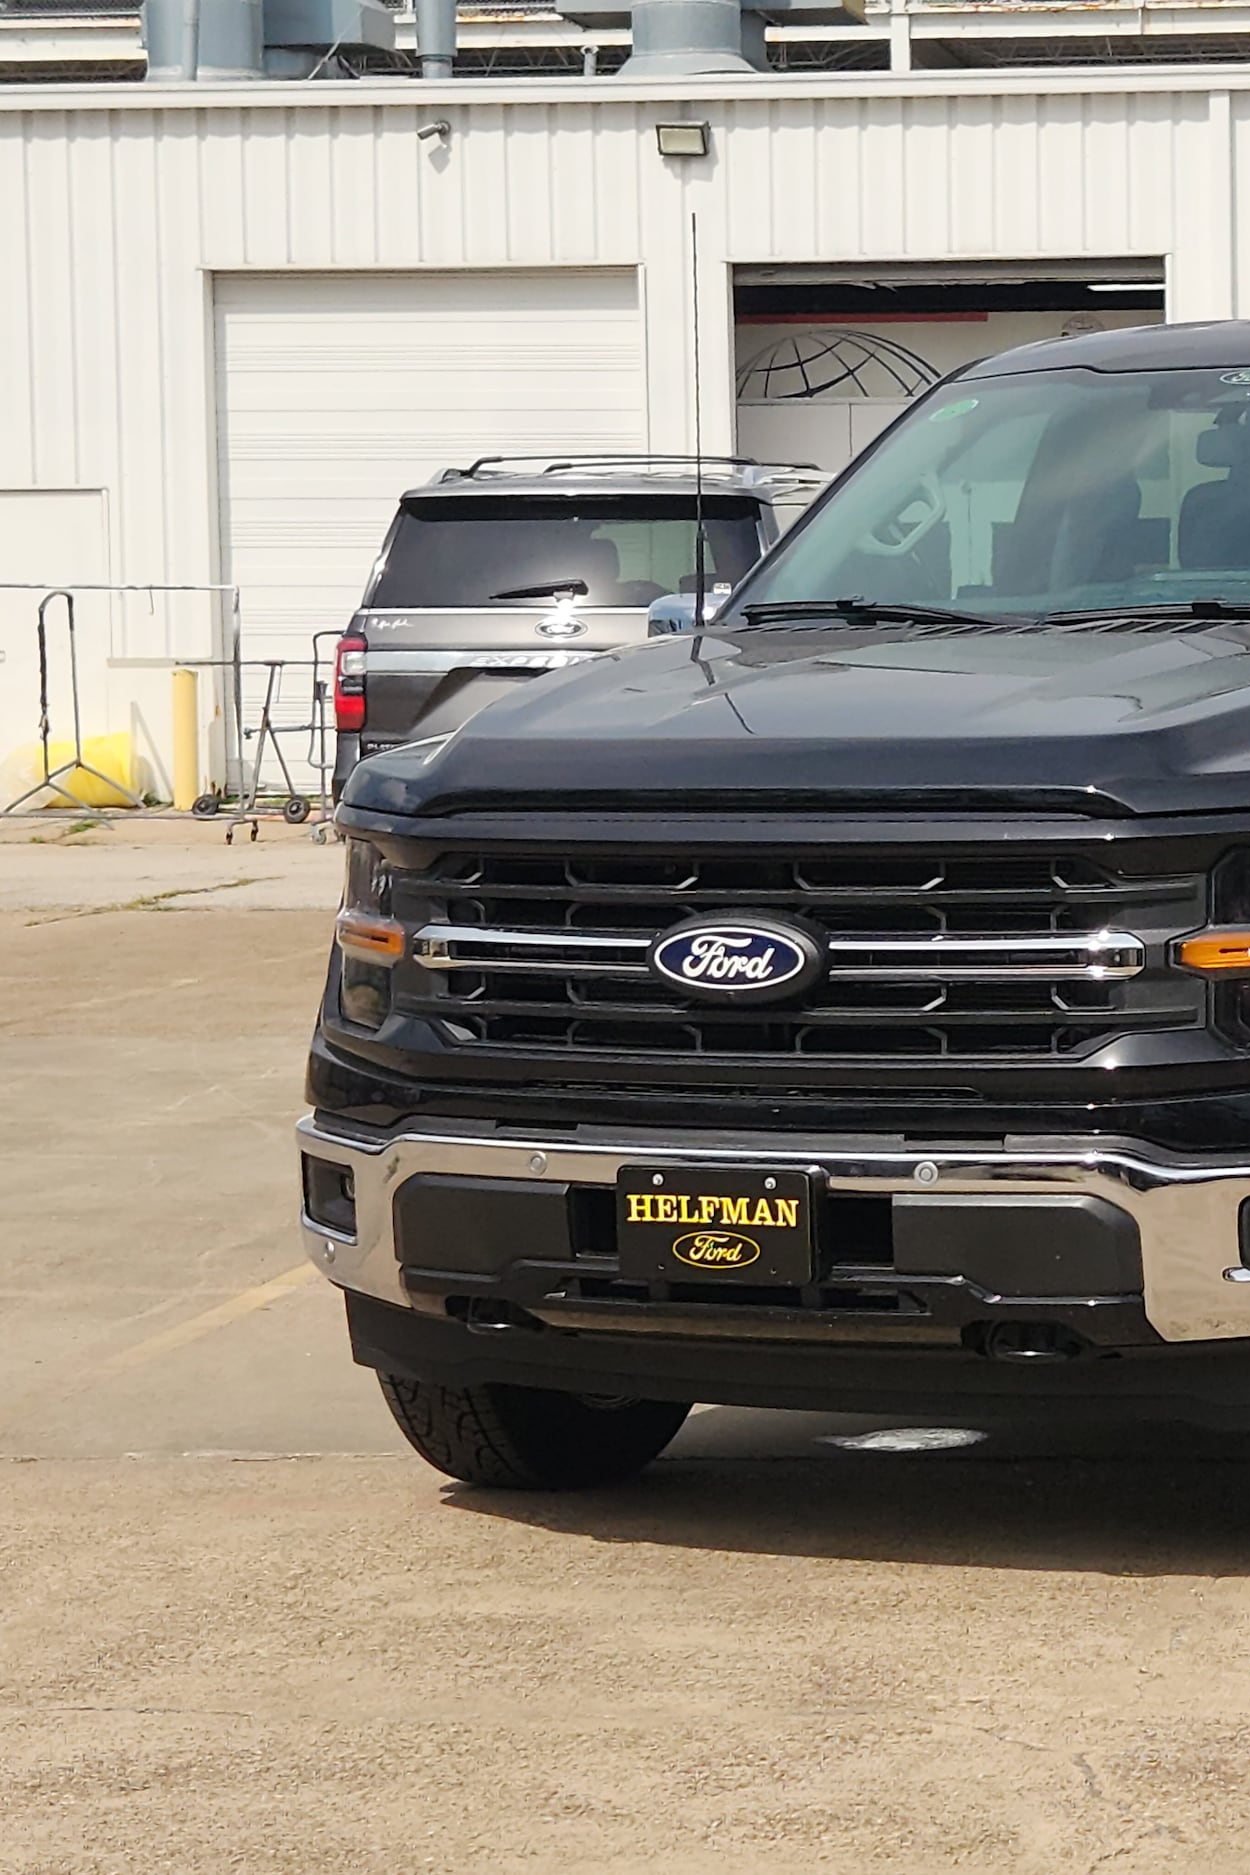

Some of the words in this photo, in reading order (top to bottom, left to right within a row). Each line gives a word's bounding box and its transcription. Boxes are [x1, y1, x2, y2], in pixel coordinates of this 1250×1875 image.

[682, 935, 775, 979] Ford
[626, 1194, 799, 1227] HELFMAN
[689, 1234, 742, 1262] Ford
